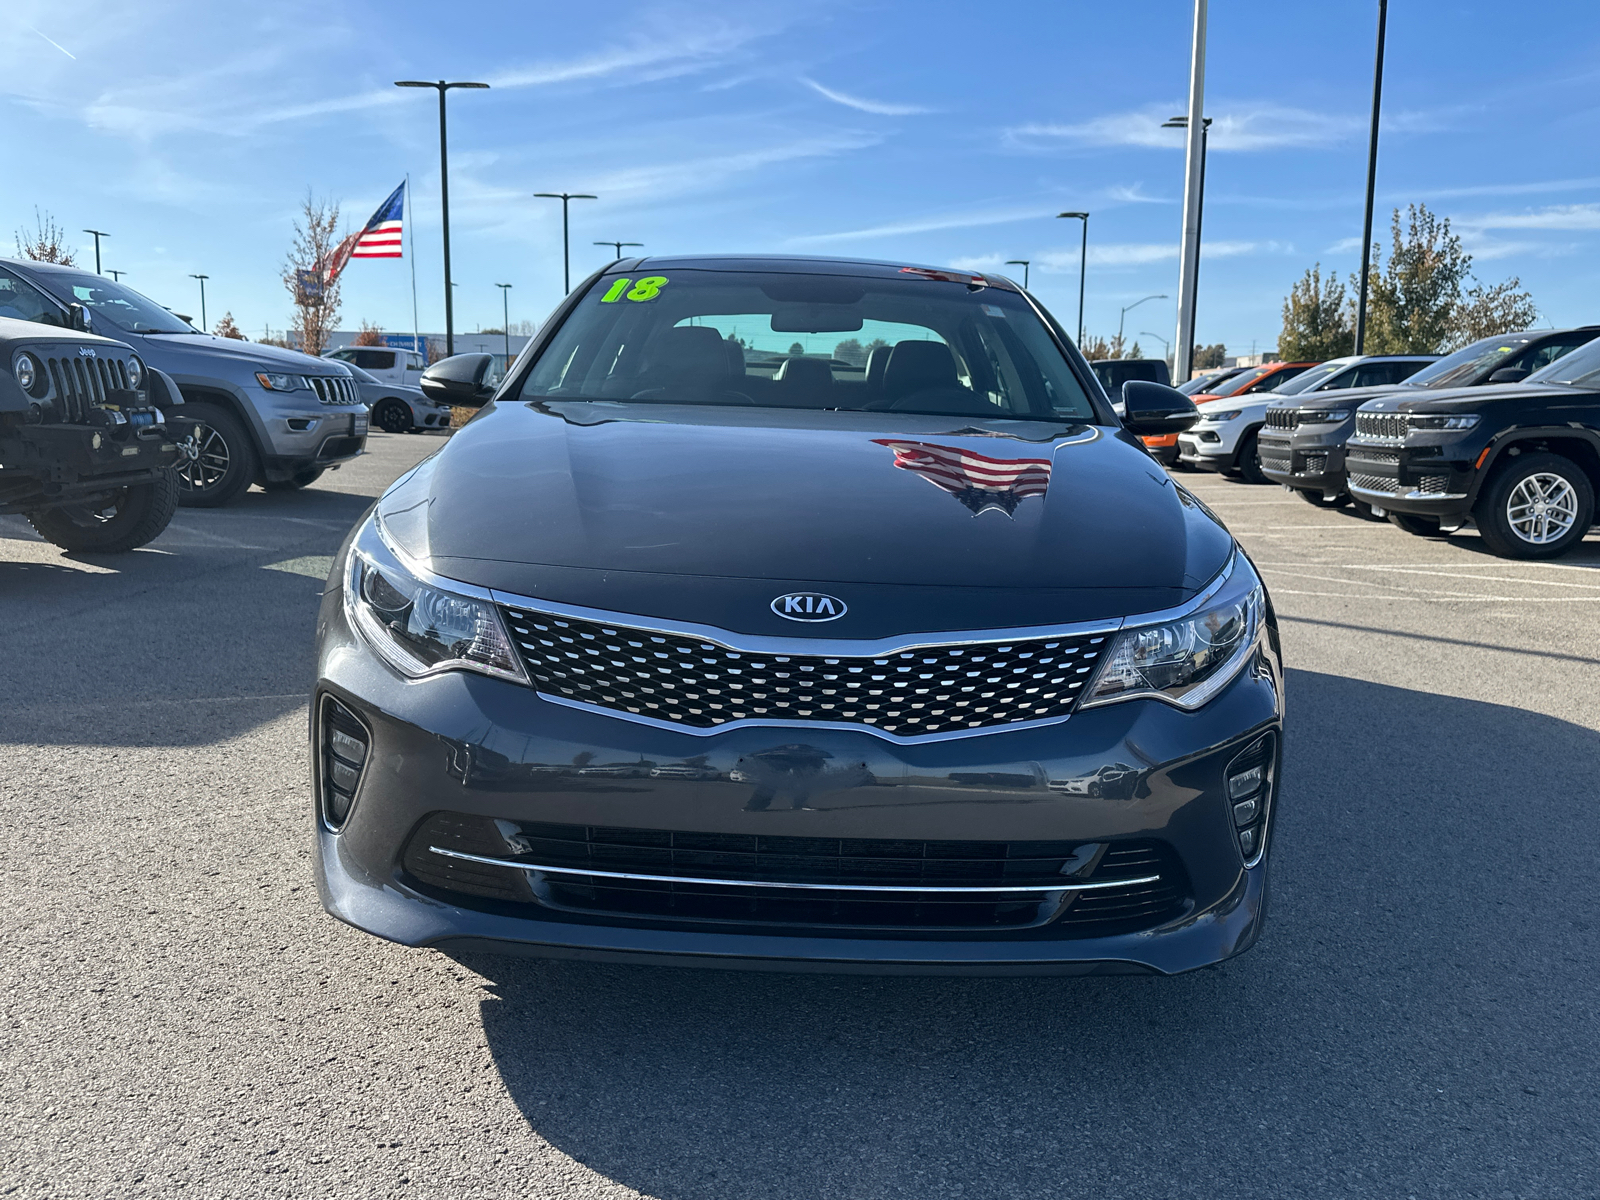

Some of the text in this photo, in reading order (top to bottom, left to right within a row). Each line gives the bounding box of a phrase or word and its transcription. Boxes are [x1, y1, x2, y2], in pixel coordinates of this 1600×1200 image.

[601, 276, 669, 303] 18
[79, 346, 96, 358] Jeep
[784, 596, 836, 615] KIA
